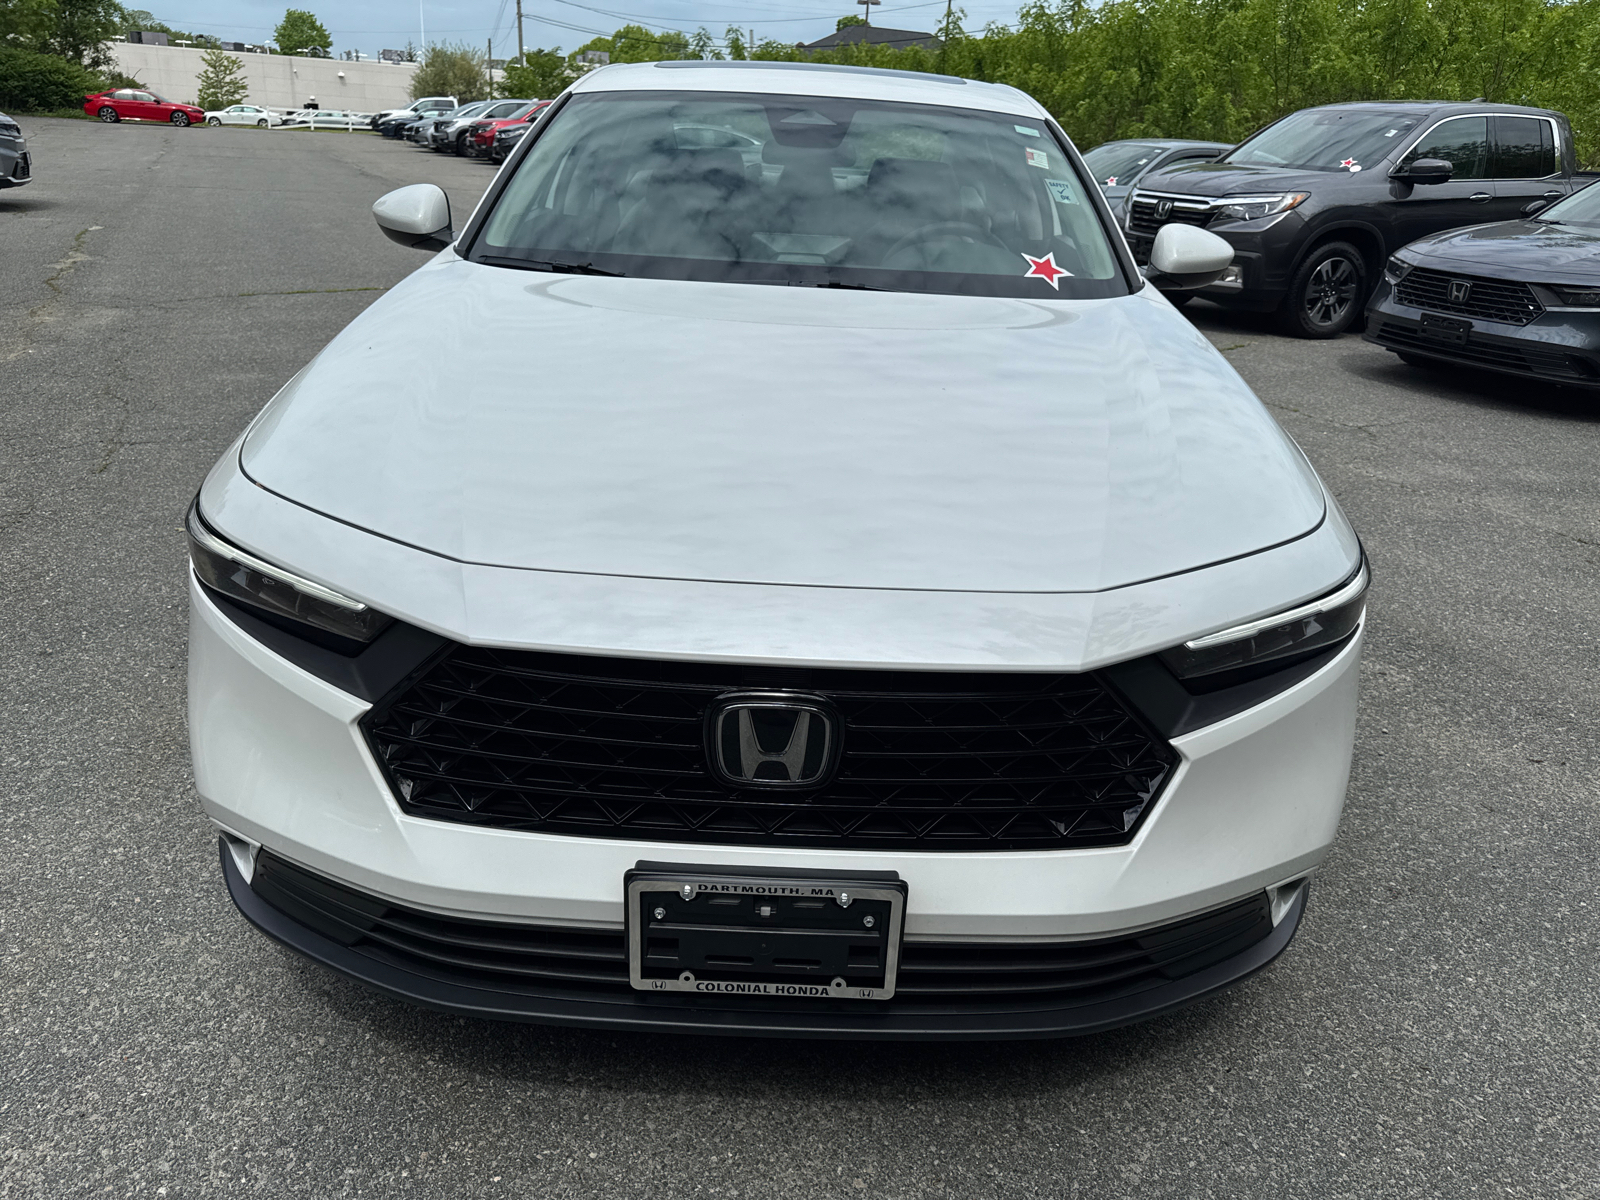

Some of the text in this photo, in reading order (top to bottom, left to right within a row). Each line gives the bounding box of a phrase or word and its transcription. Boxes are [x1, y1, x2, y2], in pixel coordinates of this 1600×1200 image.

[1048, 181, 1069, 189] SAFETY
[697, 884, 835, 896] DARTMOUTH, MA
[695, 982, 830, 997] COLONIAL HONDA
